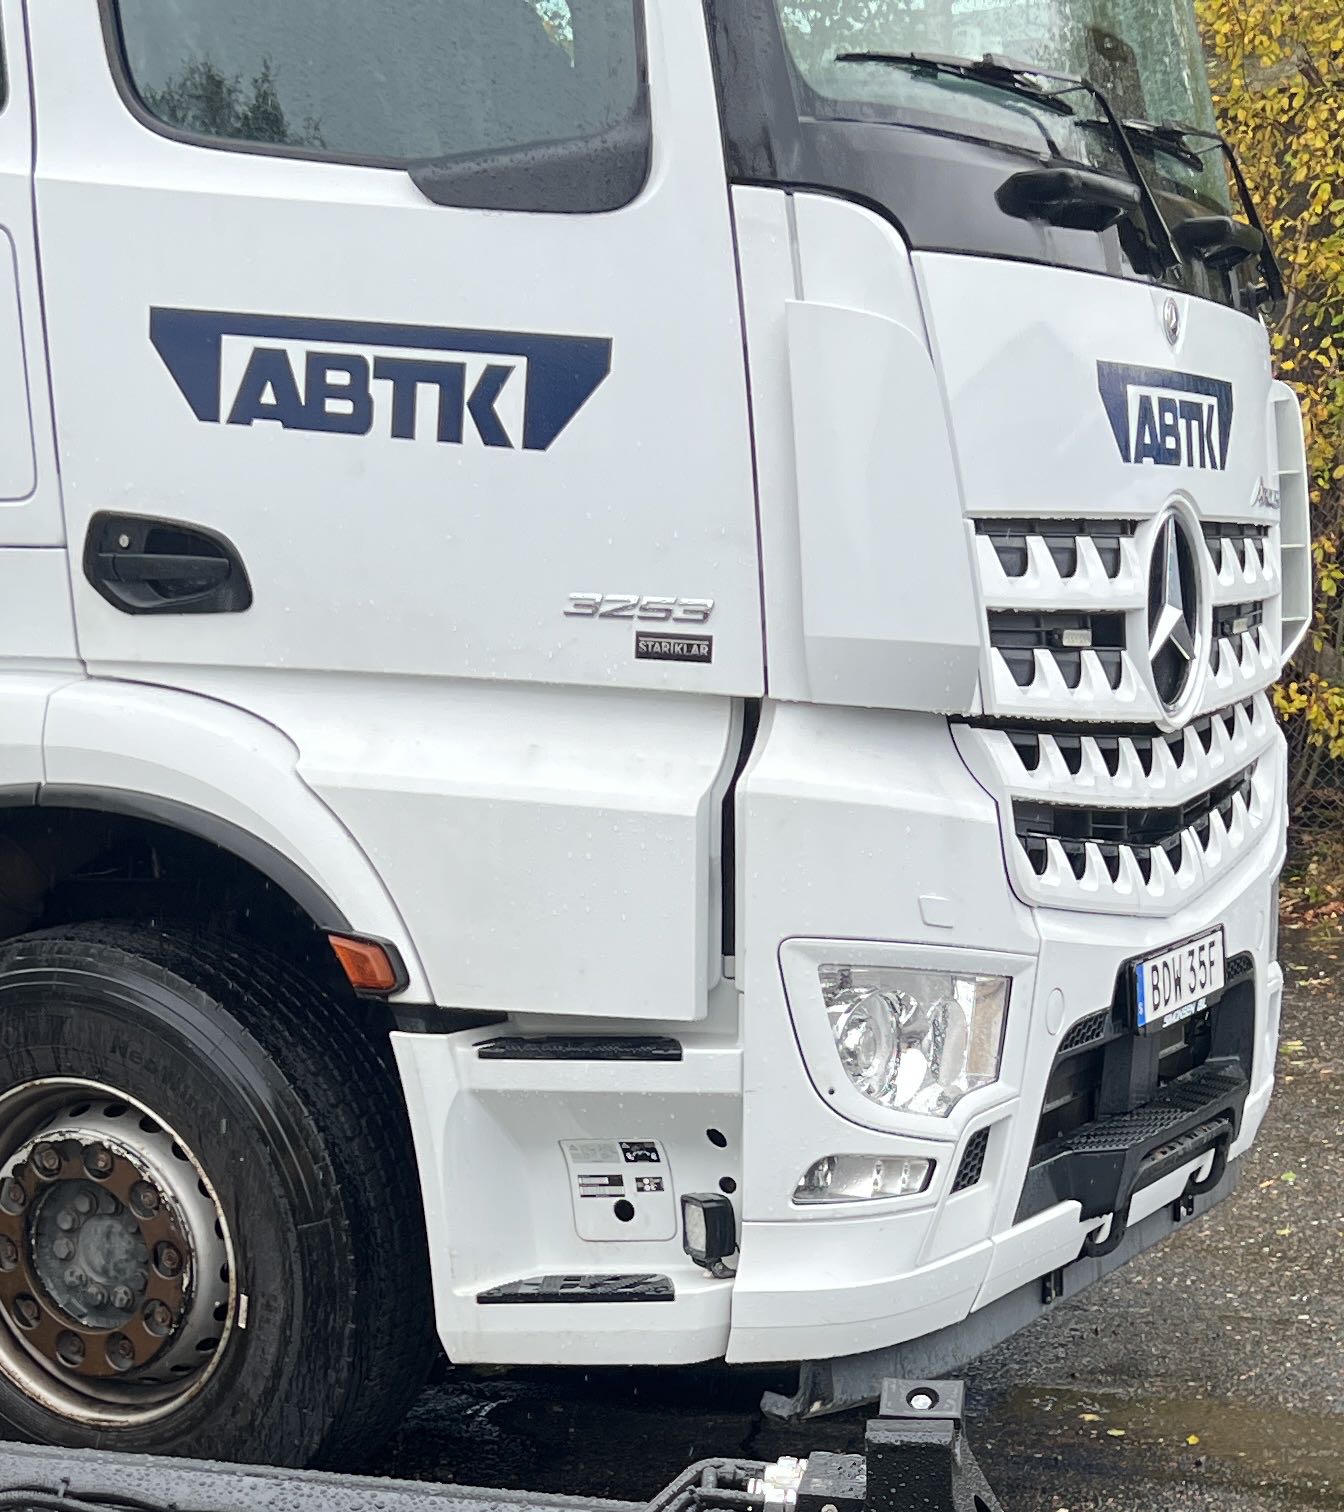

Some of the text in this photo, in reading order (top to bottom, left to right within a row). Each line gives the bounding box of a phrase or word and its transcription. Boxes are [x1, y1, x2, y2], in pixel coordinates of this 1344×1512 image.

[226, 347, 516, 449] ABTK
[1133, 395, 1218, 470] ABTK
[563, 592, 715, 624] 3253
[1151, 940, 1216, 1012] BDW 35F
